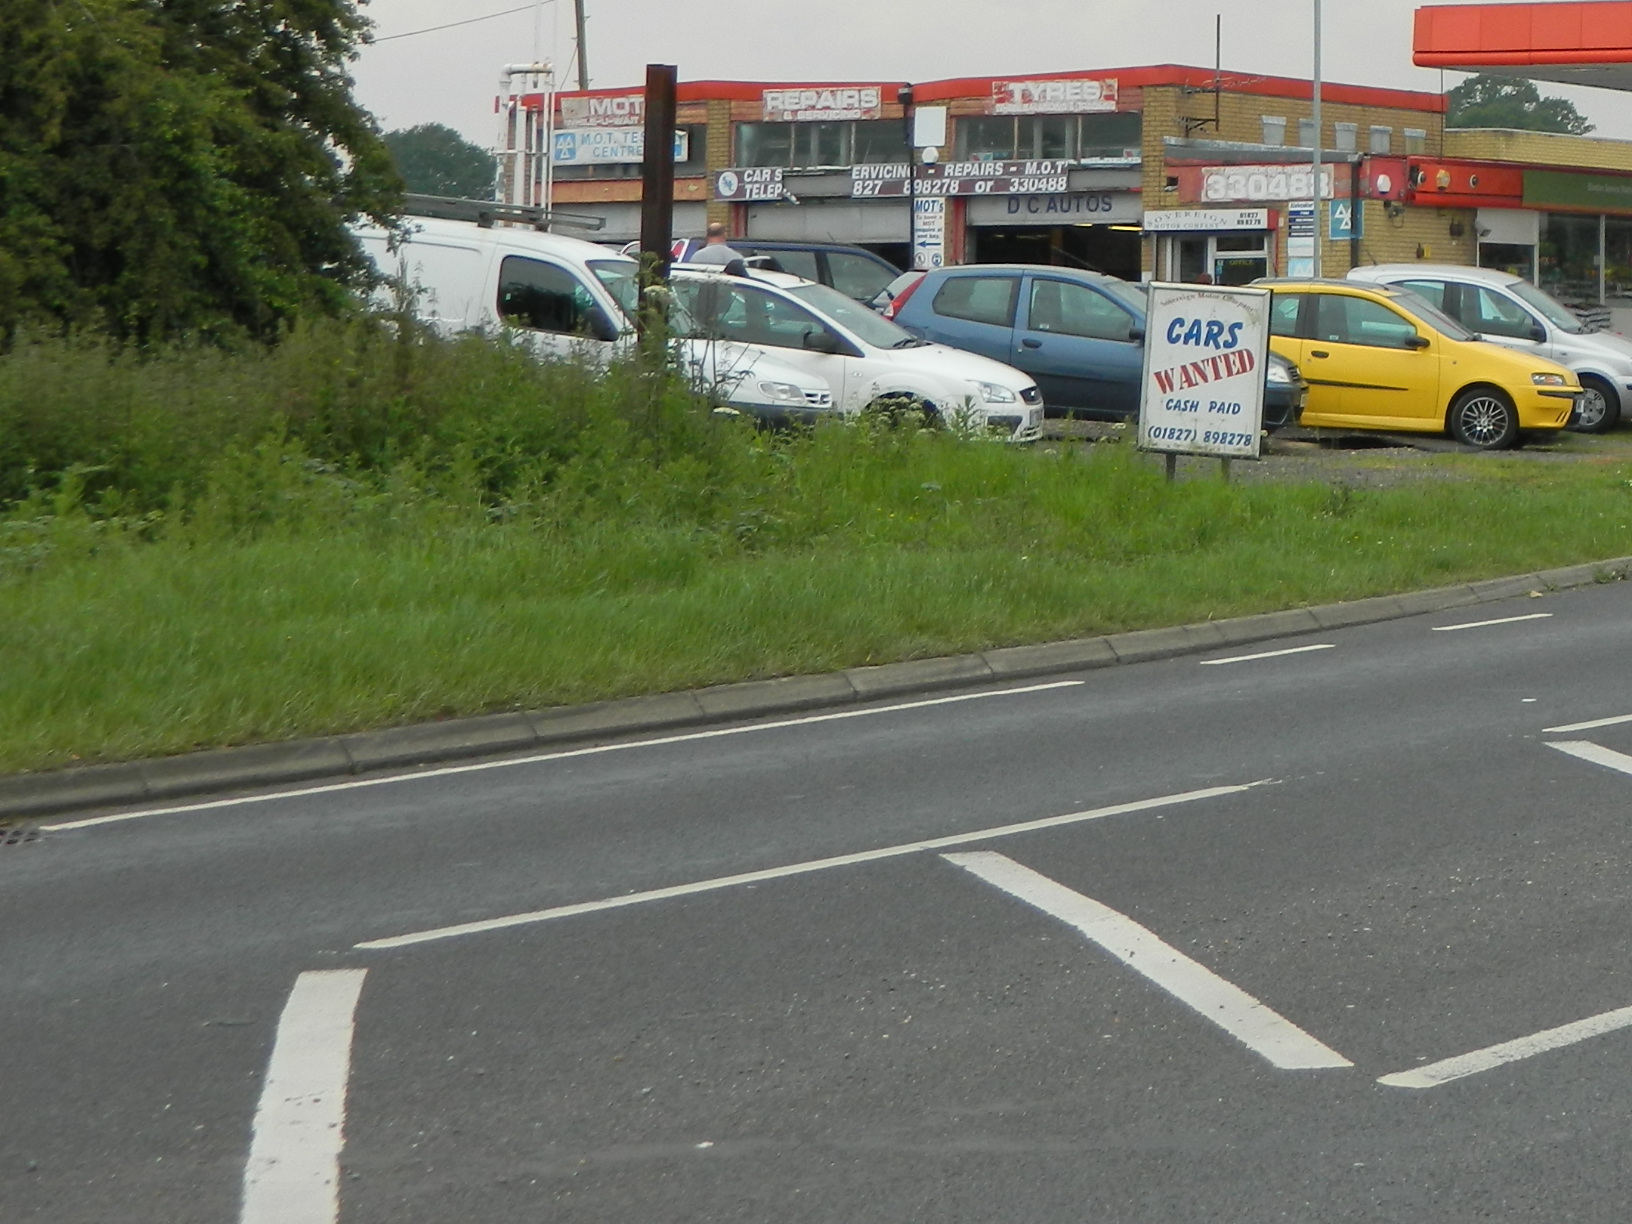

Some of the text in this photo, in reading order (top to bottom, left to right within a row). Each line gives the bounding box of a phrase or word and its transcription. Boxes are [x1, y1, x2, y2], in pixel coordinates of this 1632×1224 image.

[766, 89, 880, 111] REPAIRS
[1008, 80, 1102, 104] TYRES
[589, 97, 645, 116] MOT
[623, 131, 645, 144] TES
[592, 145, 643, 158] CENTRE
[743, 170, 771, 182] CAR
[944, 161, 1003, 177] REPAIRS
[744, 182, 783, 200] TELEP
[852, 180, 882, 196] 827
[902, 179, 960, 195] 898278
[974, 179, 995, 194] or
[1009, 176, 1068, 193] 330488
[1045, 194, 1113, 214] AUTOS
[1146, 211, 1229, 227] SOVEREIGN
[1167, 317, 1244, 350] CARS
[1153, 348, 1255, 395] WANTED
[1165, 398, 1241, 415] CASH PAID
[1147, 425, 1253, 447] (01827) 898278
